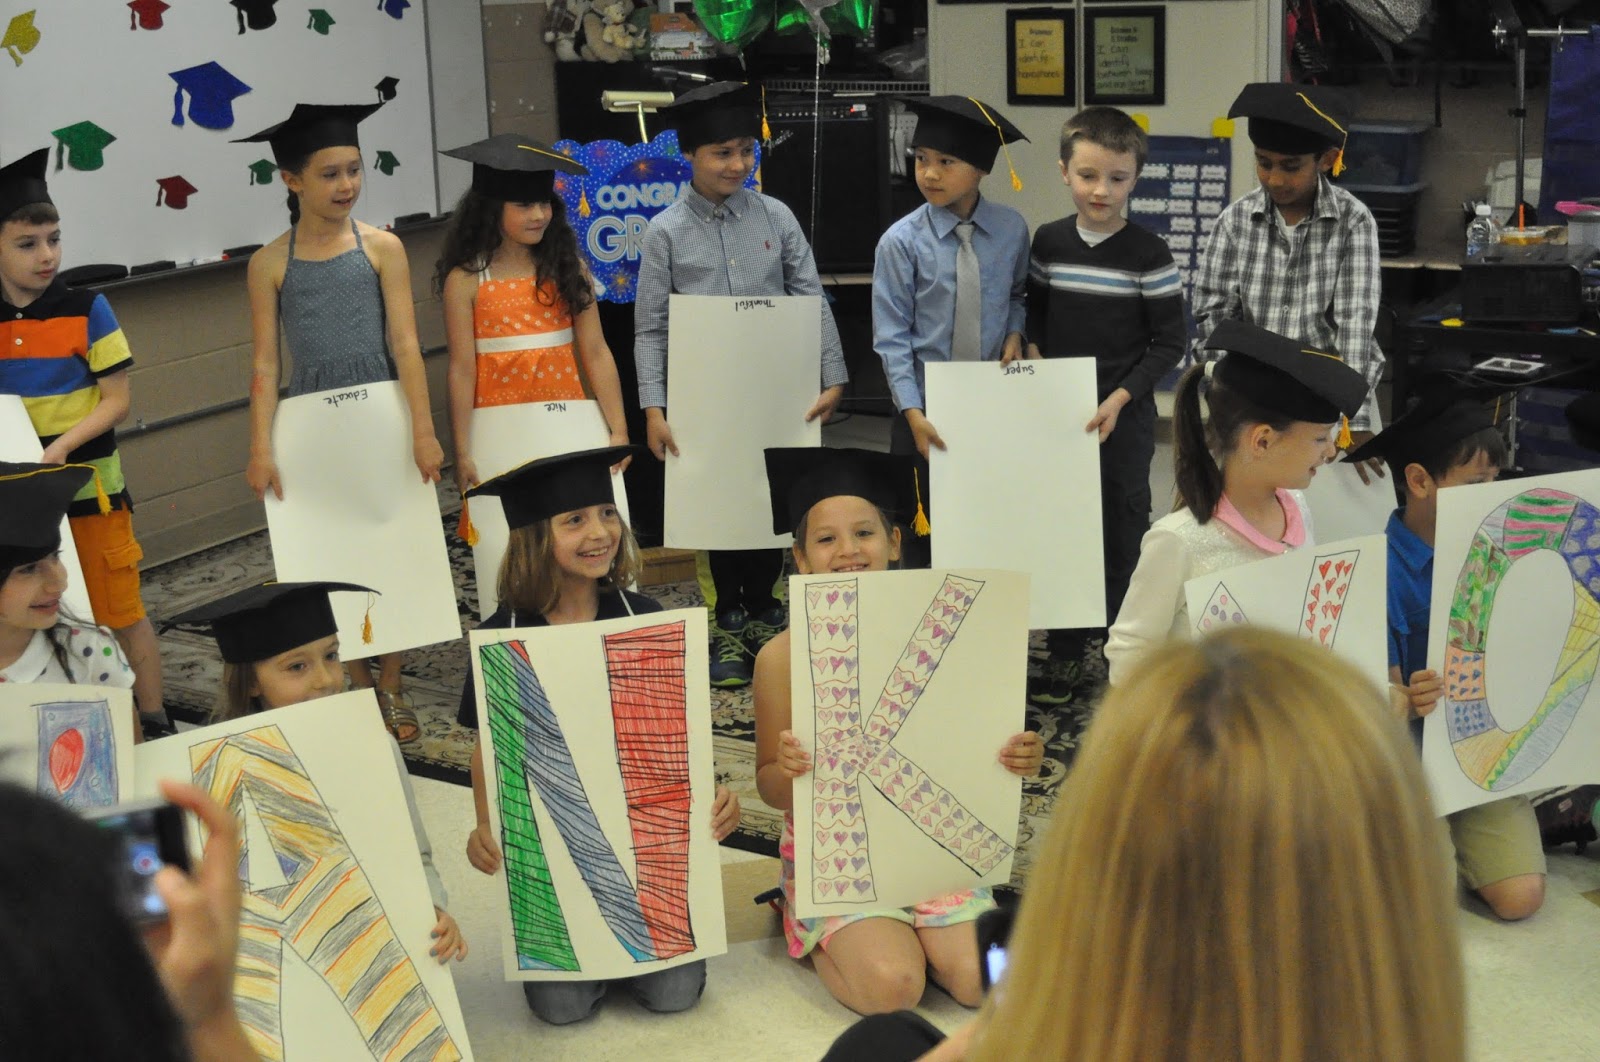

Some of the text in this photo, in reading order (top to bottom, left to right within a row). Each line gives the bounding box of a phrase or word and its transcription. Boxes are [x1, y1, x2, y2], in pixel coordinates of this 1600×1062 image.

[735, 299, 776, 312] Thankful
[1003, 362, 1035, 376] Super
[323, 388, 369, 408] Educate
[544, 402, 567, 413] Nice
[806, 575, 1016, 905] K
[479, 620, 698, 973] N
[188, 723, 463, 1062] A
